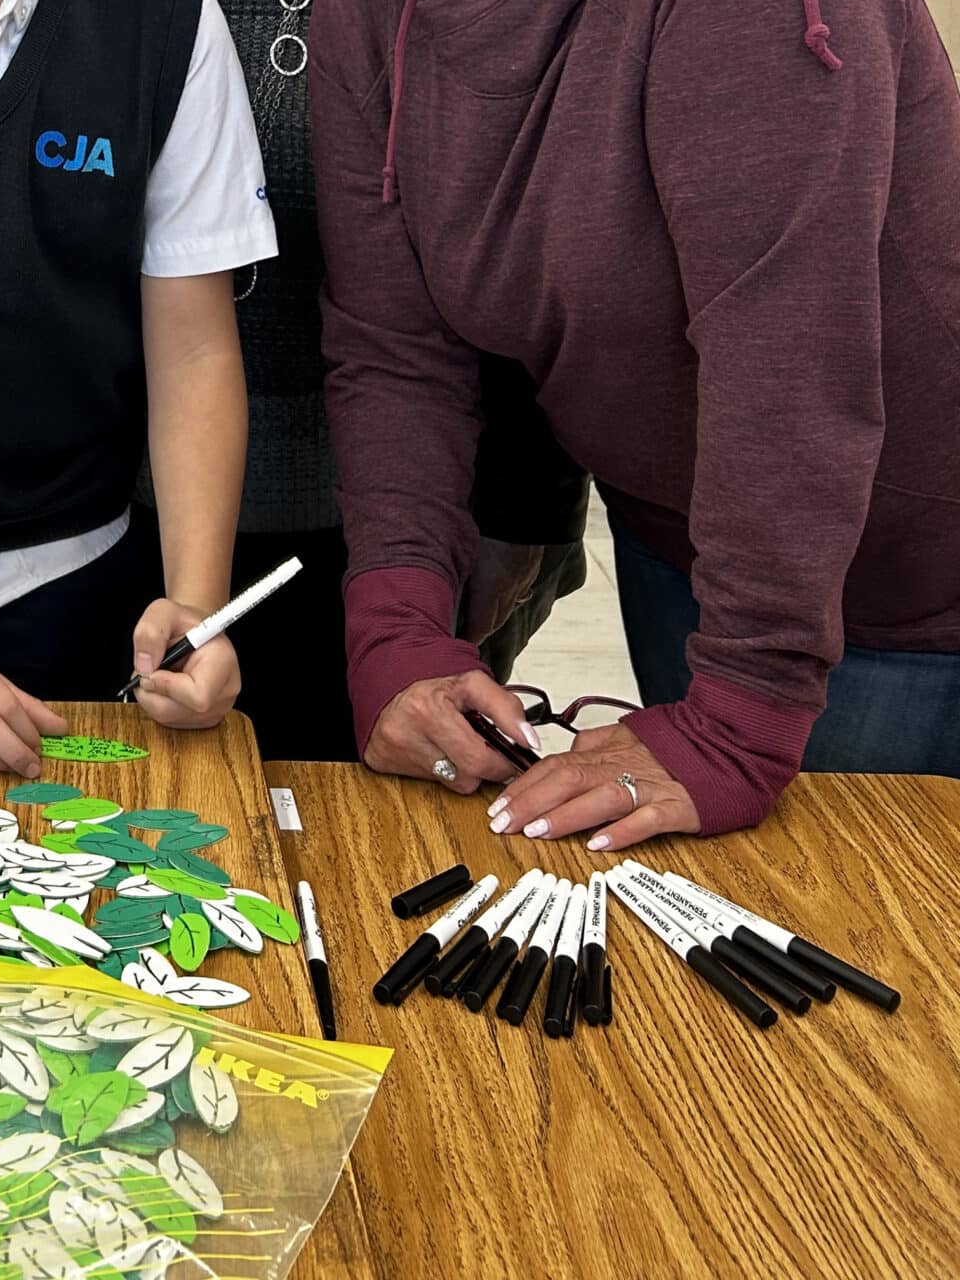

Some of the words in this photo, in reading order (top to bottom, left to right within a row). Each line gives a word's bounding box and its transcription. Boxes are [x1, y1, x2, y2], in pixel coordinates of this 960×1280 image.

[35, 130, 115, 178] CJA
[594, 880, 602, 899] MARKER
[617, 882, 638, 902] MARKER
[629, 874, 655, 897] MARKER
[638, 871, 667, 891] MARKER
[592, 900, 601, 927] PERMANENT
[637, 901, 673, 933] PERMANENT
[655, 893, 695, 921] PERMANENT
[667, 888, 709, 919] PERMANENT
